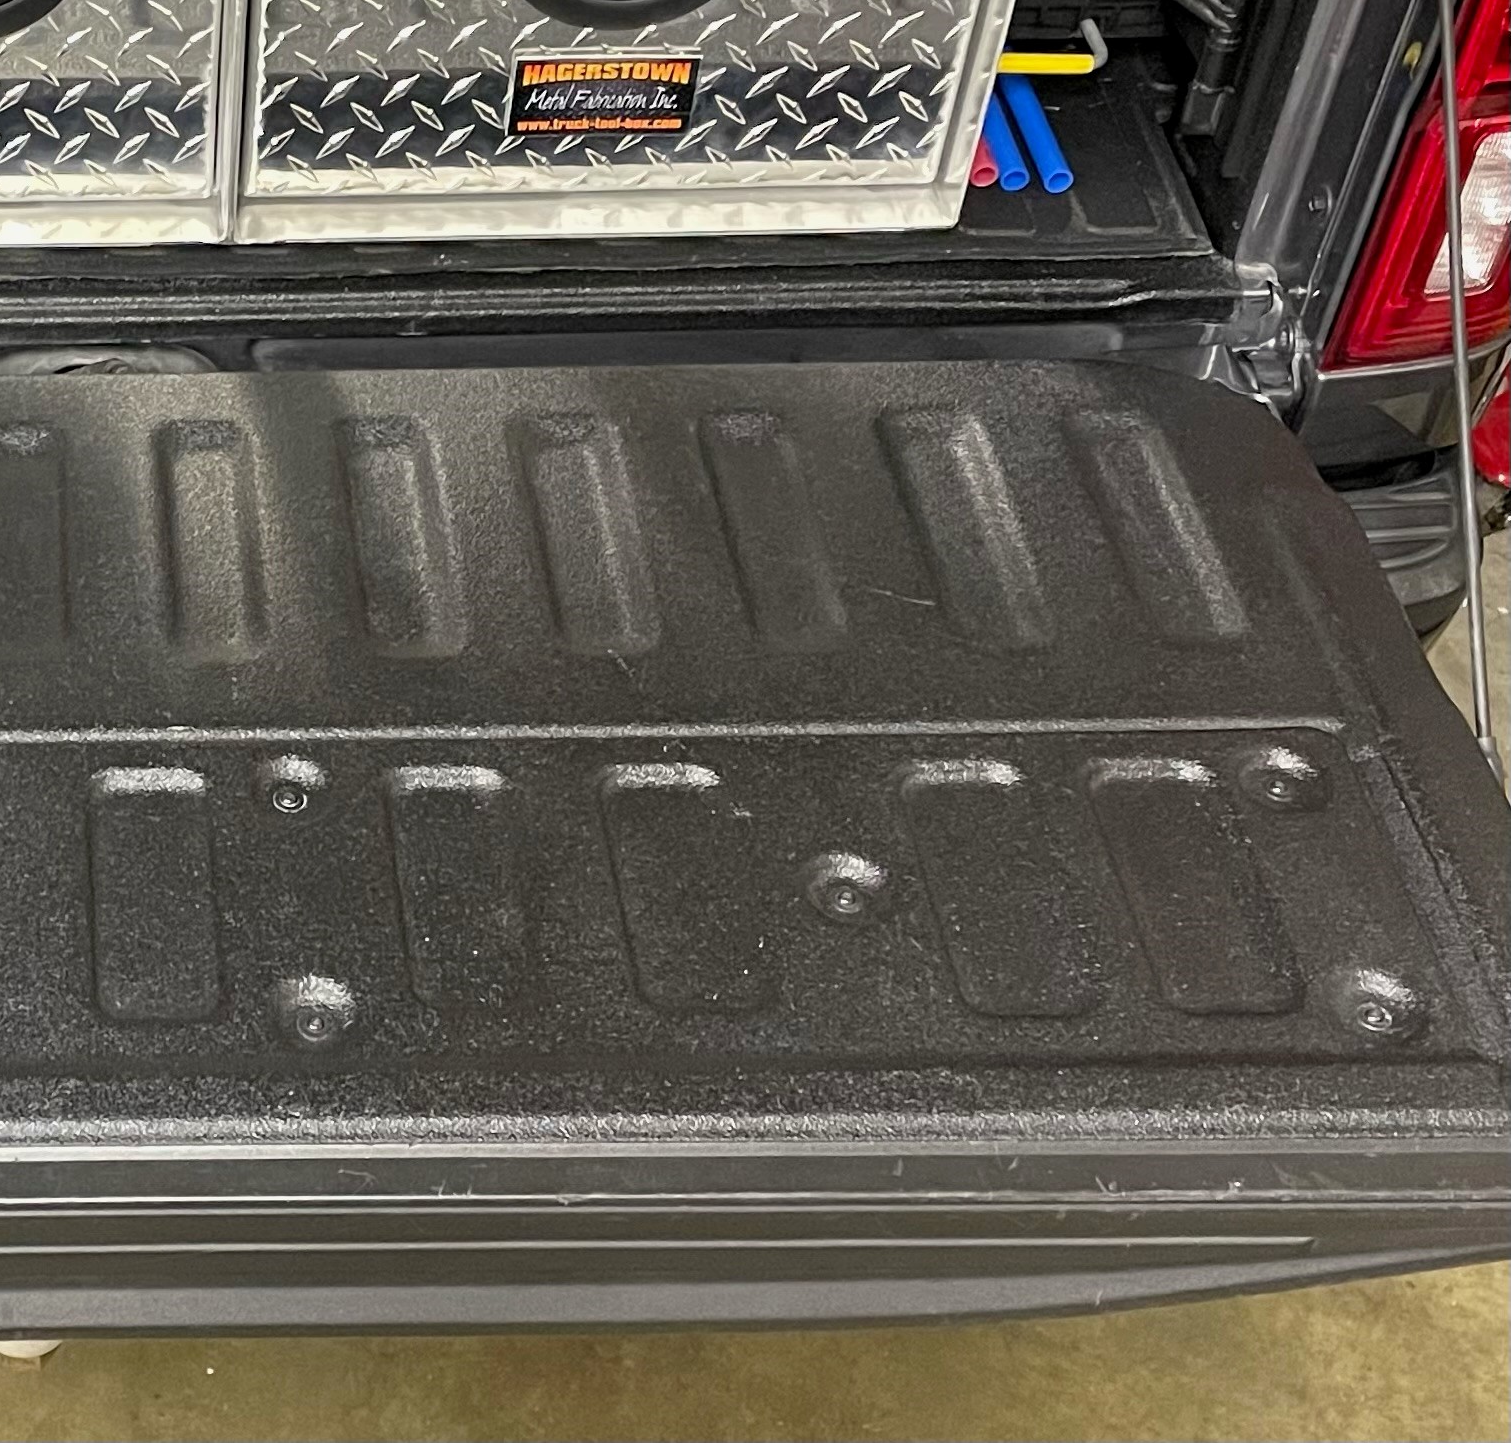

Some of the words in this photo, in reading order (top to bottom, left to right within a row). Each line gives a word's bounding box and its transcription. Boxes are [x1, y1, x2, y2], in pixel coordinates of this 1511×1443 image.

[523, 63, 691, 85] HAGERSTOWN
[525, 84, 572, 110] Metal
[572, 89, 647, 109] Fabrication
[649, 87, 678, 109] Inc.
[517, 118, 682, 131] www.truck-tool-box.com
